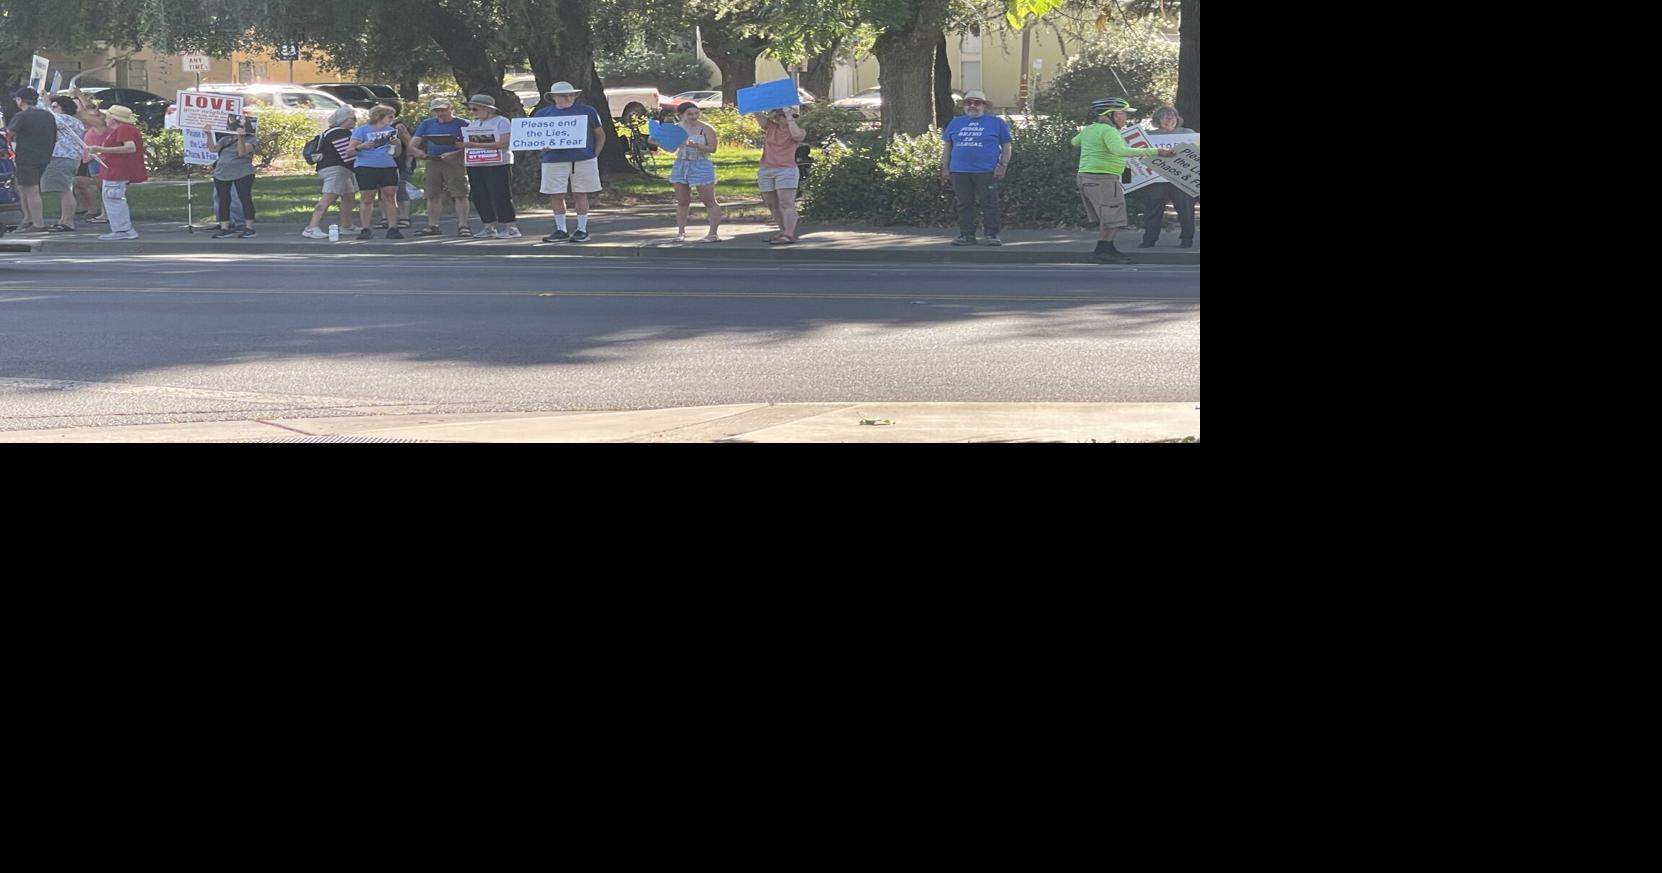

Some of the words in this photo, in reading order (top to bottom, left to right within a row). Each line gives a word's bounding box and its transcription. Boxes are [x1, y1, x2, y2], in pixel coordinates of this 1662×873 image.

[185, 95, 235, 112] LOVE
[557, 119, 577, 127] end
[512, 139, 546, 148] Chaos
[559, 138, 584, 146] Fear
[1173, 157, 1191, 168] the
[1151, 158, 1183, 176] Chaos
[1180, 173, 1192, 181] &
